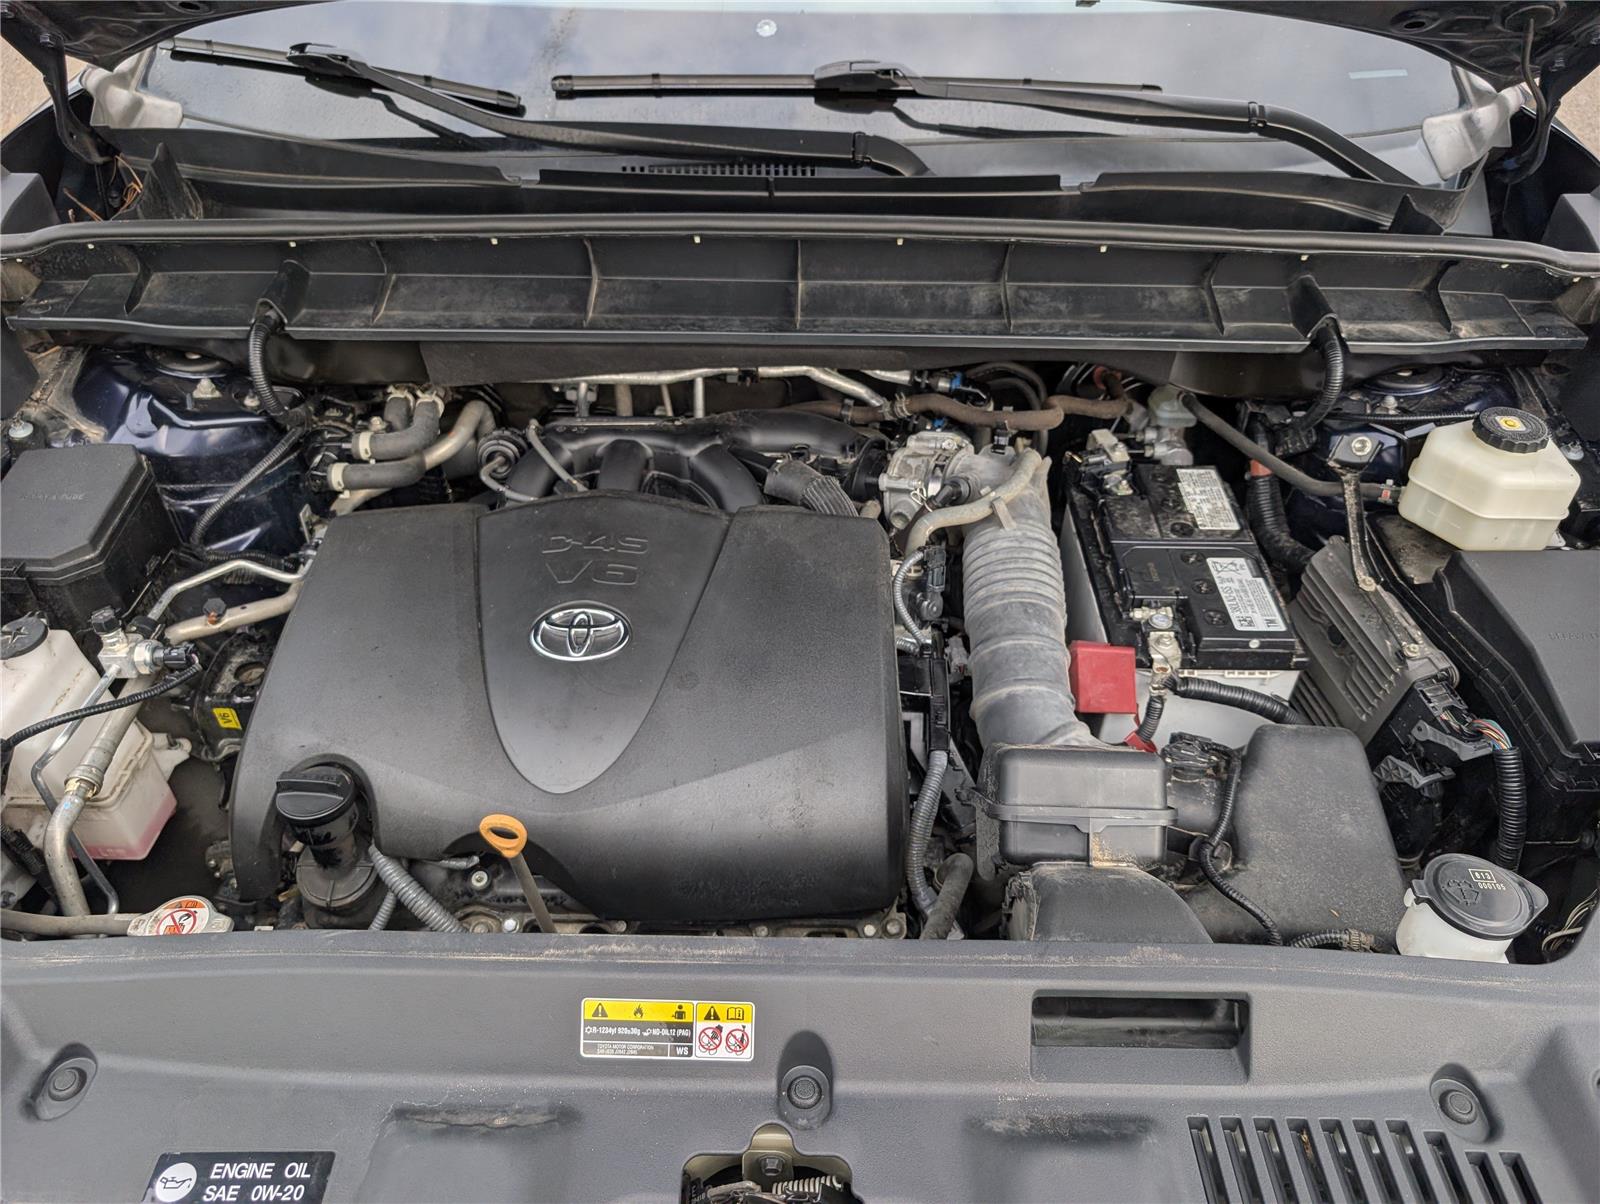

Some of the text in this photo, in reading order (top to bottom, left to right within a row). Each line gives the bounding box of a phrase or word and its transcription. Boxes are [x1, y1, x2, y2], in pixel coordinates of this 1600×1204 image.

[544, 559, 641, 587] V6
[592, 1025, 617, 1036] R-1234yf
[676, 1028, 691, 1038] (PAG)
[676, 1046, 689, 1056] WS
[210, 1162, 311, 1179] ENGINE OIL
[203, 1184, 305, 1202] SAE 0W-20
